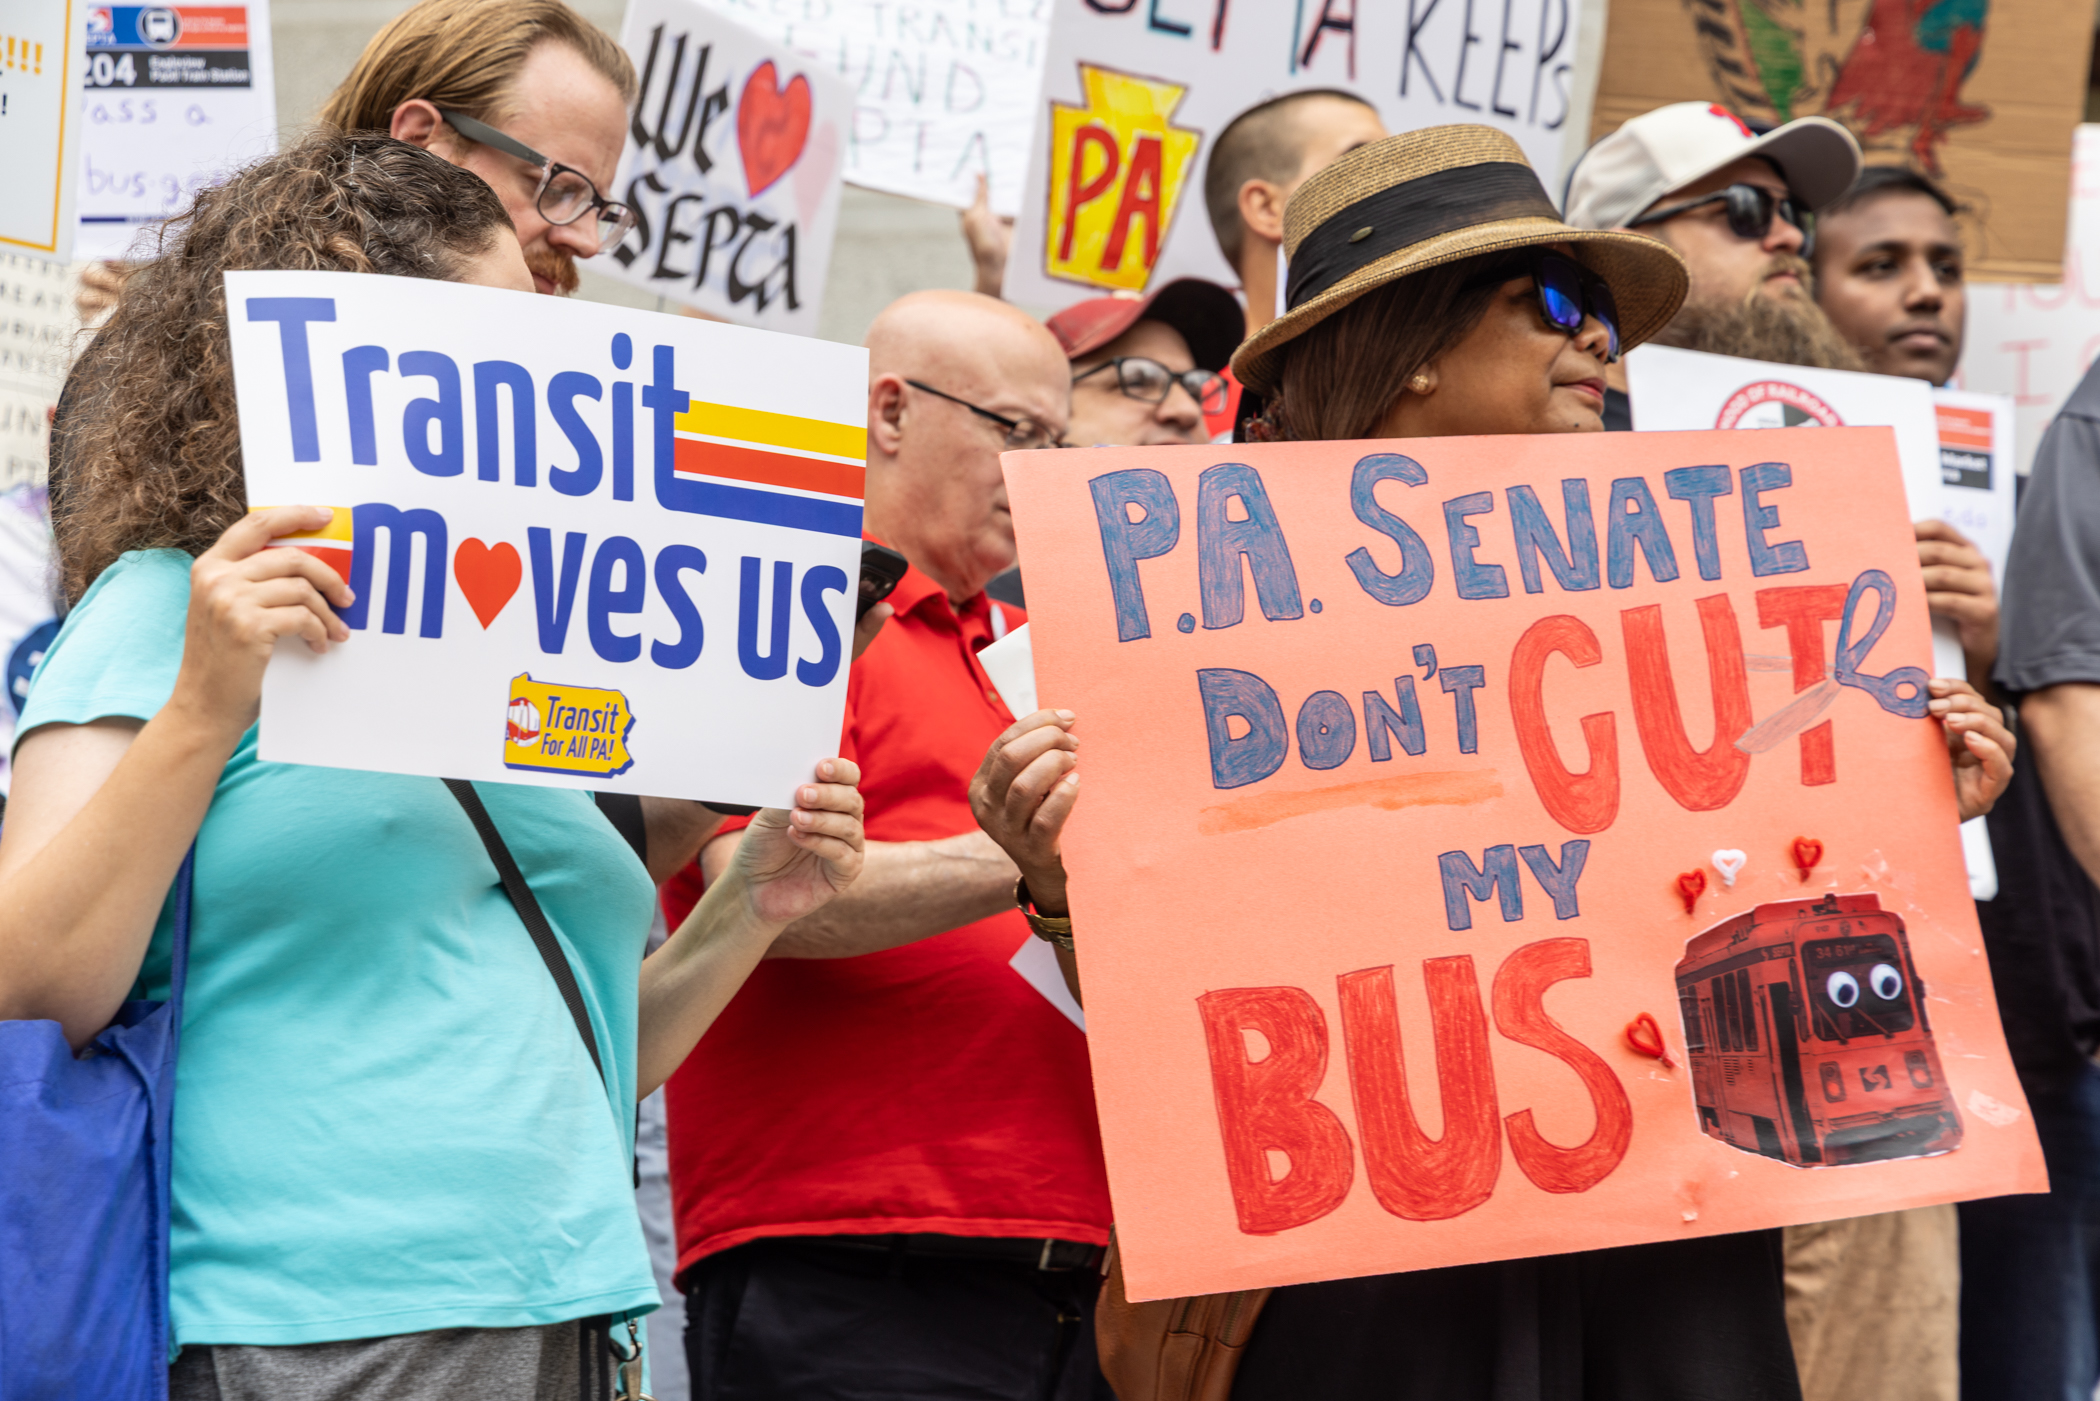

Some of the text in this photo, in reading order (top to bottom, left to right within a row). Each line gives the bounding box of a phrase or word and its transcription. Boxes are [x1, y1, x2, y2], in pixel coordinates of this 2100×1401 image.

[84, 52, 136, 87] 204
[631, 22, 729, 174] We
[865, 1, 1037, 69] TRANSI
[1398, 0, 1571, 131] KEEPS
[83, 97, 158, 125] ass
[848, 105, 993, 188] PTA
[612, 172, 803, 314] SEPTA
[1059, 126, 1162, 271] PA
[246, 297, 691, 511] Transit
[349, 503, 848, 688] mves us
[1089, 453, 1811, 641] P.A. SENATE
[541, 733, 615, 761] For All PA!
[546, 696, 620, 734] Transit
[1196, 583, 1850, 835] DON'T CUT
[1437, 840, 1592, 931] MY
[1196, 937, 1634, 1236] BUS
